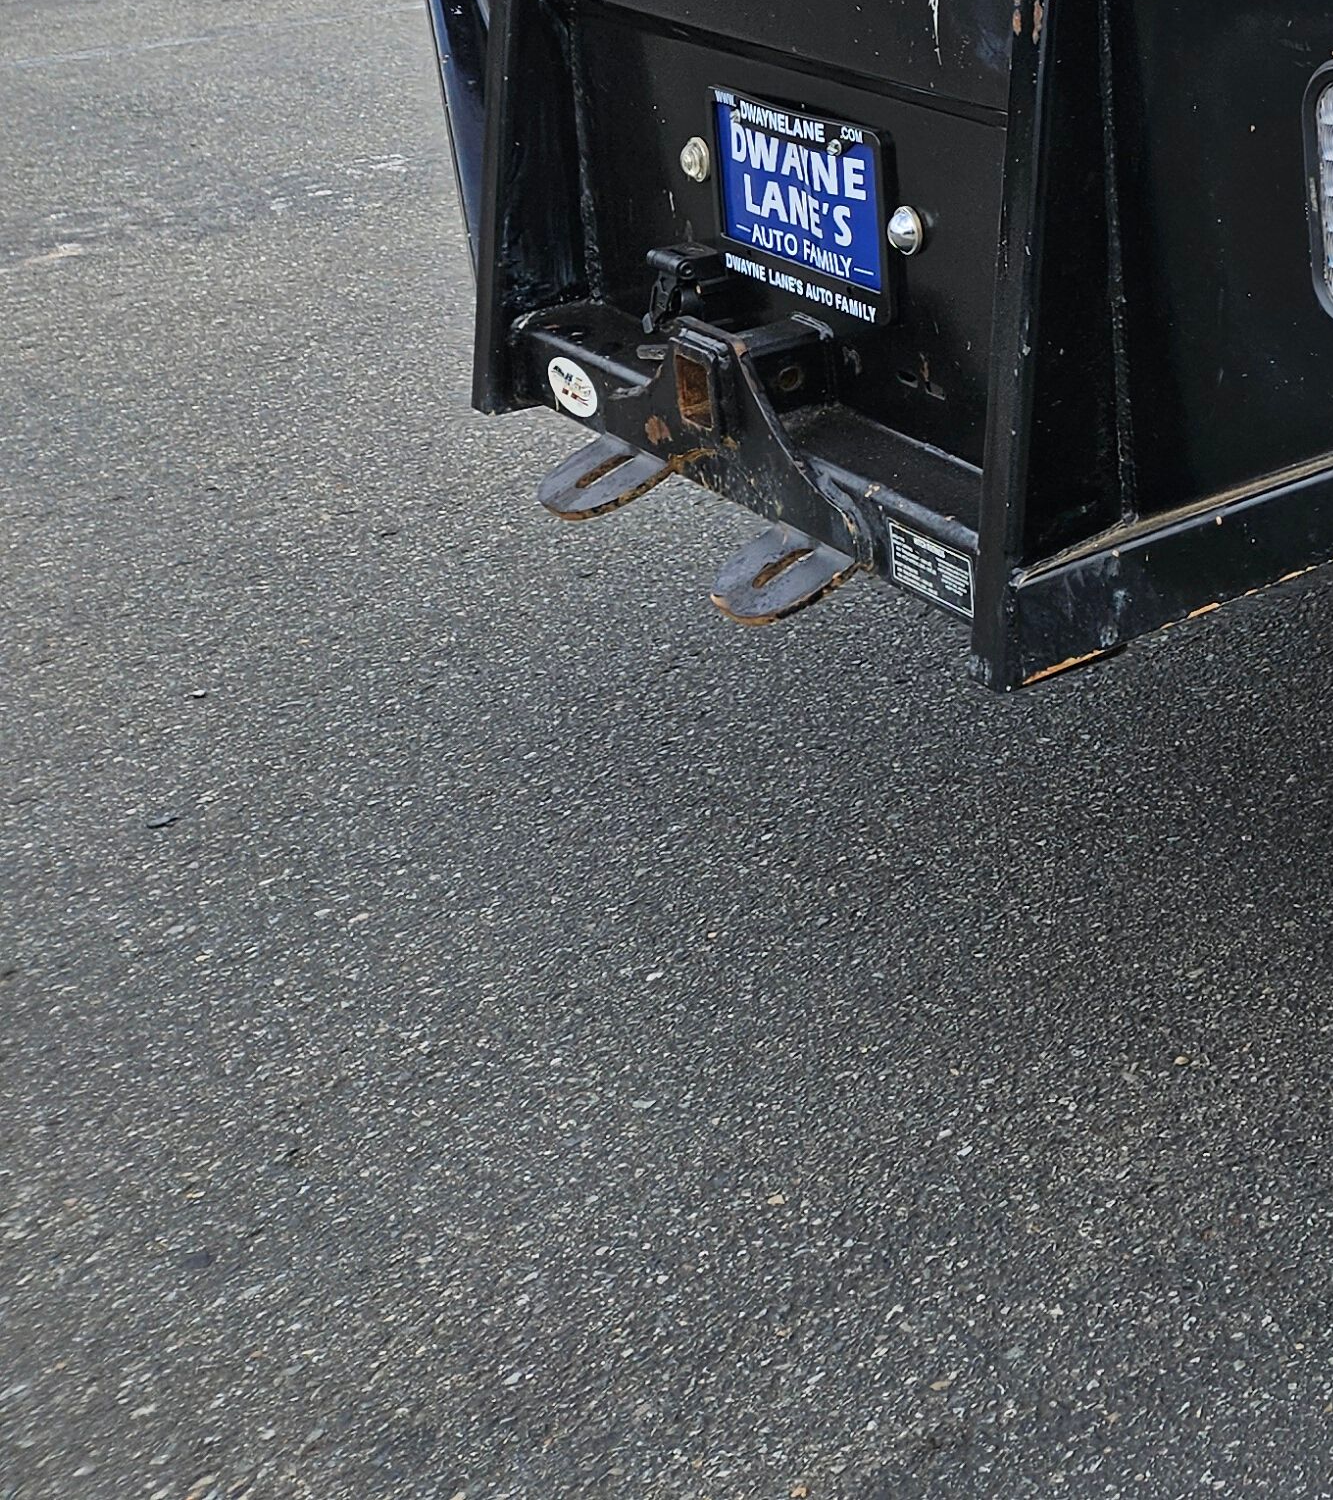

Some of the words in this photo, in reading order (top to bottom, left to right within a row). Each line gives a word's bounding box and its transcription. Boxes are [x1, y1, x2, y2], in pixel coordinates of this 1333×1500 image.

[740, 100, 825, 143] DWAYNELANE
[731, 121, 867, 201] DWAYNE
[743, 173, 852, 247] LANE'S
[752, 223, 798, 256] AUTO
[803, 238, 853, 279] FAMILY
[725, 252, 766, 282] DWAYNE
[768, 271, 804, 296] LANE'S
[805, 283, 834, 307] AUTO
[835, 293, 877, 324] FAMILY
